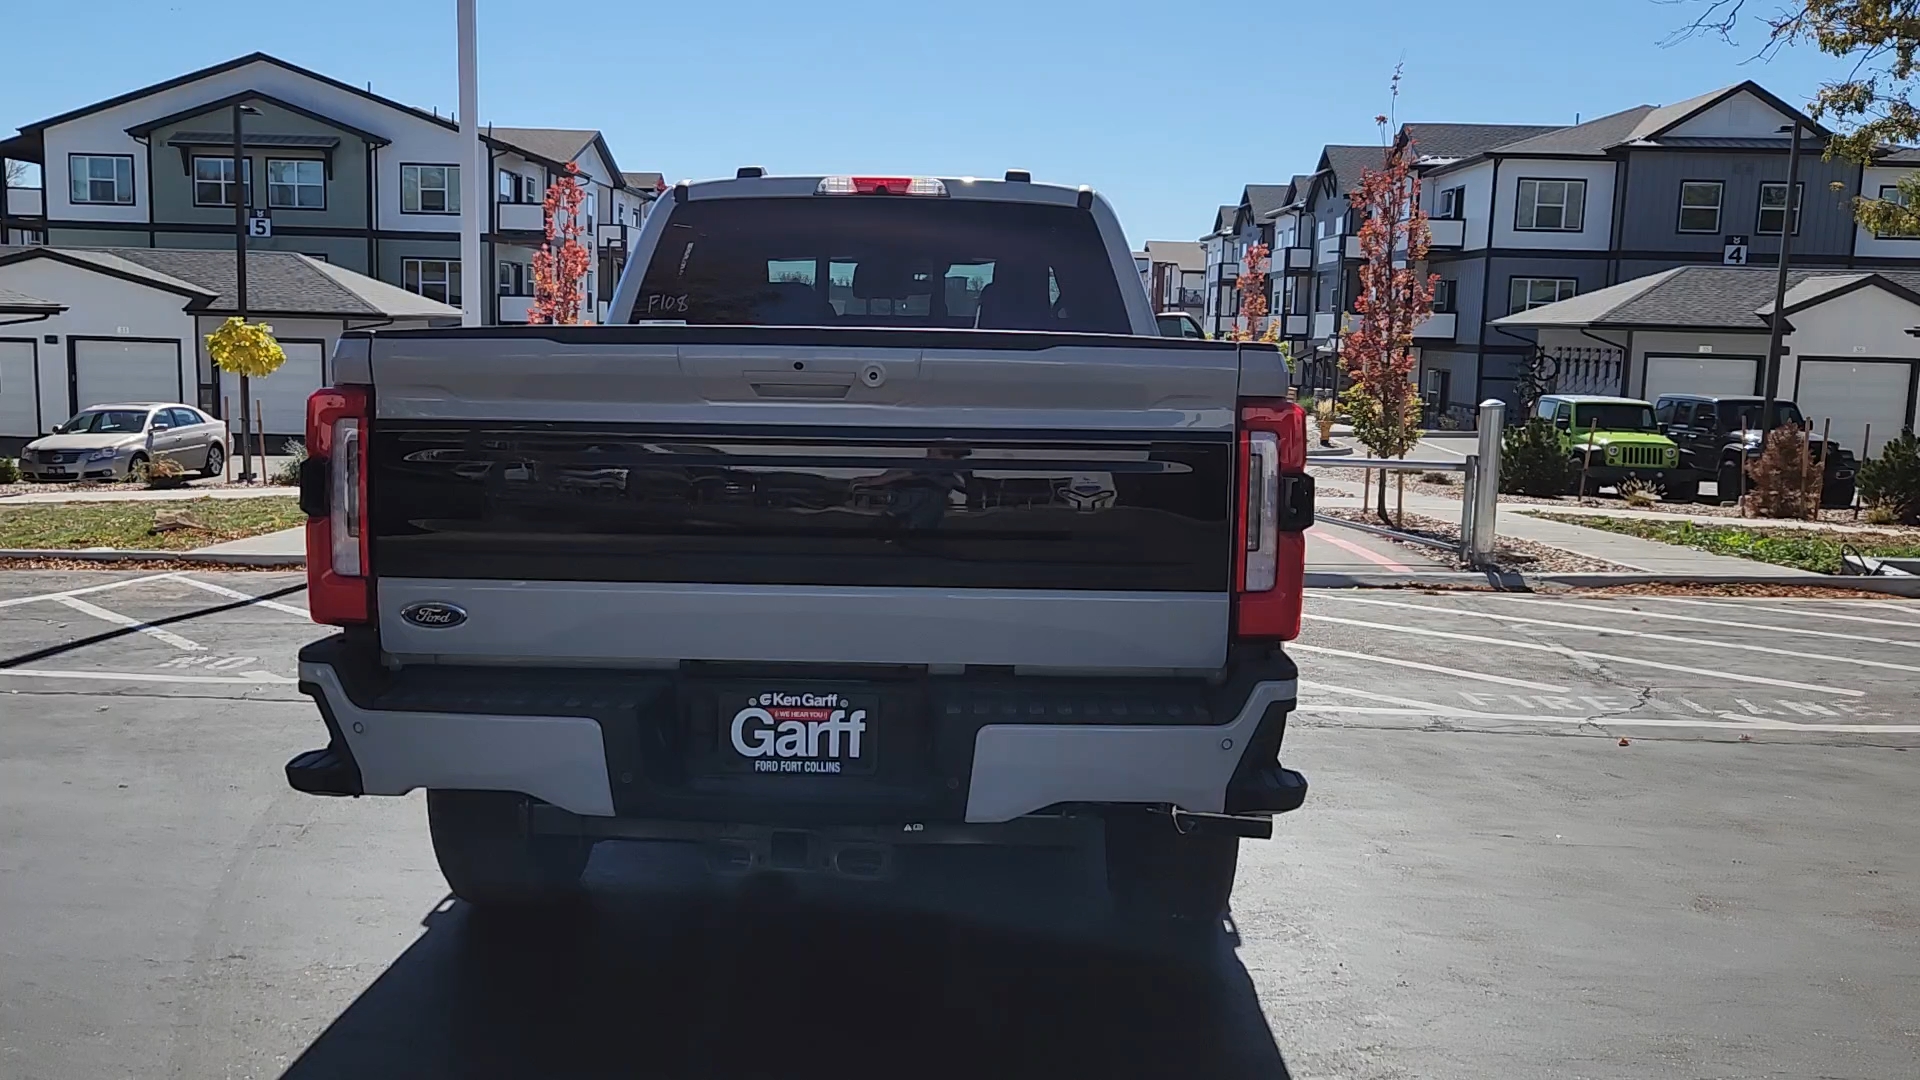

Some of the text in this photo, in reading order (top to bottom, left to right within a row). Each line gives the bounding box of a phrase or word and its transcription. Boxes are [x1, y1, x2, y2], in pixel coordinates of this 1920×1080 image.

[255, 219, 267, 235] 5
[1727, 246, 1743, 264] 4
[647, 294, 689, 313] F108
[415, 607, 451, 623] Ford
[773, 692, 838, 707] Ken Garff
[1457, 691, 1633, 711] FIRE
[731, 707, 866, 758] Garff
[755, 760, 841, 773] FORD FORT COLLINS
